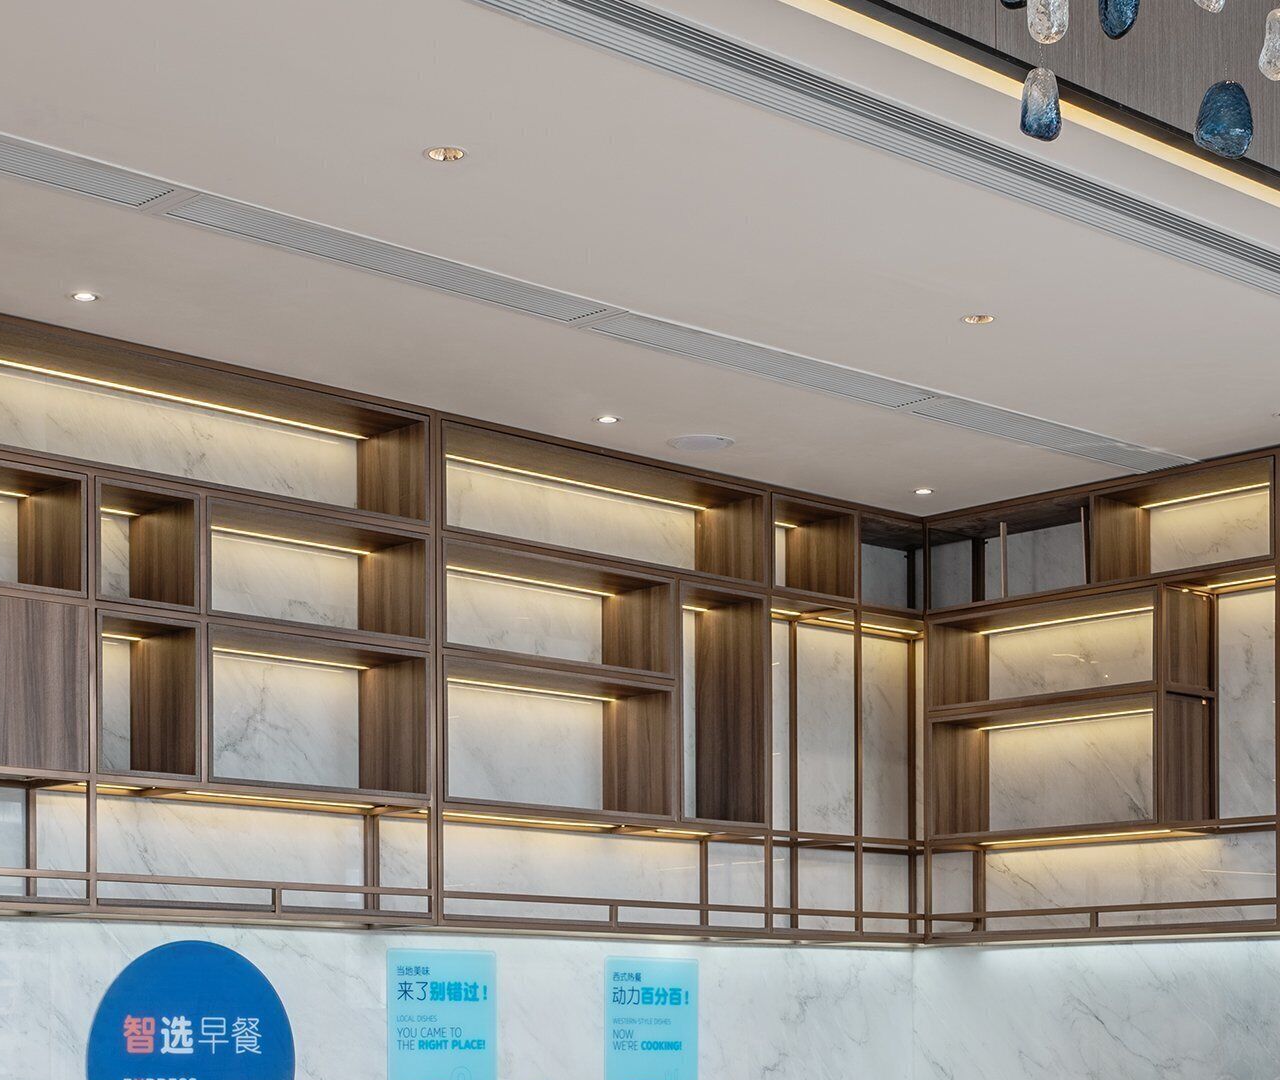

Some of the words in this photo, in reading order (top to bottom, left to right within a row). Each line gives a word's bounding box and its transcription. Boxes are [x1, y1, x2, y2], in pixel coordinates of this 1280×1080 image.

[396, 965, 431, 977] 当地美味
[397, 980, 488, 1002] 来了别错过！
[612, 985, 689, 1006] 动力百分百！
[396, 1014, 416, 1023] LOCAL
[416, 1014, 438, 1023] DISHES
[122, 1014, 263, 1055] 智选早餐
[396, 1026, 418, 1039] YOU
[419, 1026, 447, 1039] CAME
[449, 1026, 463, 1039] TO
[612, 1028, 634, 1040] NOW
[396, 1039, 416, 1051] THE
[418, 1039, 449, 1051] RIGHT
[450, 1039, 486, 1051] PLACE!
[612, 1040, 639, 1051] WE'RE
[640, 1040, 683, 1052] COOKING!
